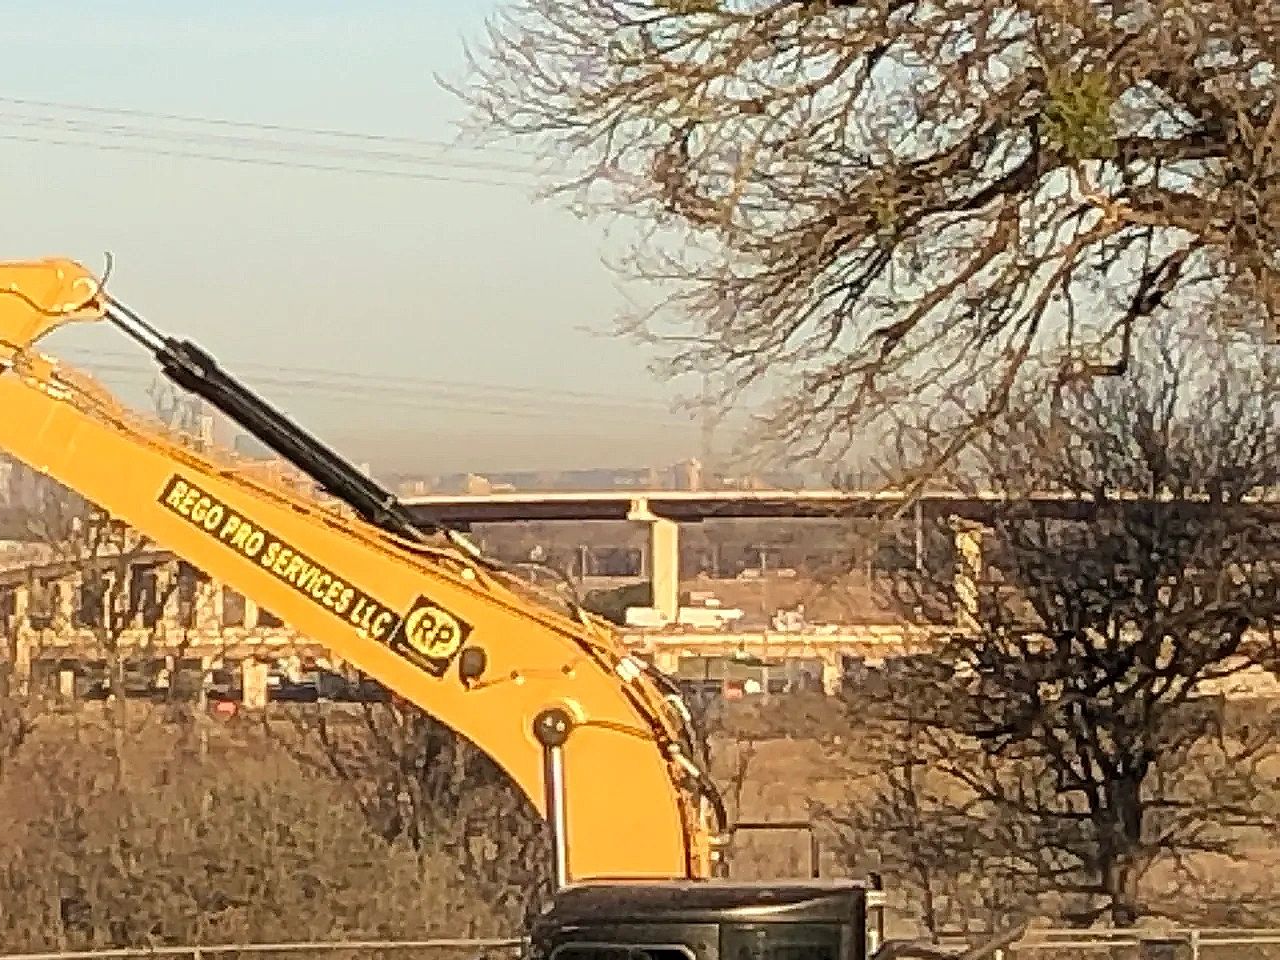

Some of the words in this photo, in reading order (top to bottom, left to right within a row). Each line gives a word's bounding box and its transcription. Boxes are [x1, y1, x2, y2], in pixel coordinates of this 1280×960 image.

[166, 481, 224, 530] REGO
[220, 515, 265, 556] PRO
[261, 542, 354, 613] SERVICES
[350, 597, 393, 637] LLC
[411, 612, 455, 651] RP
